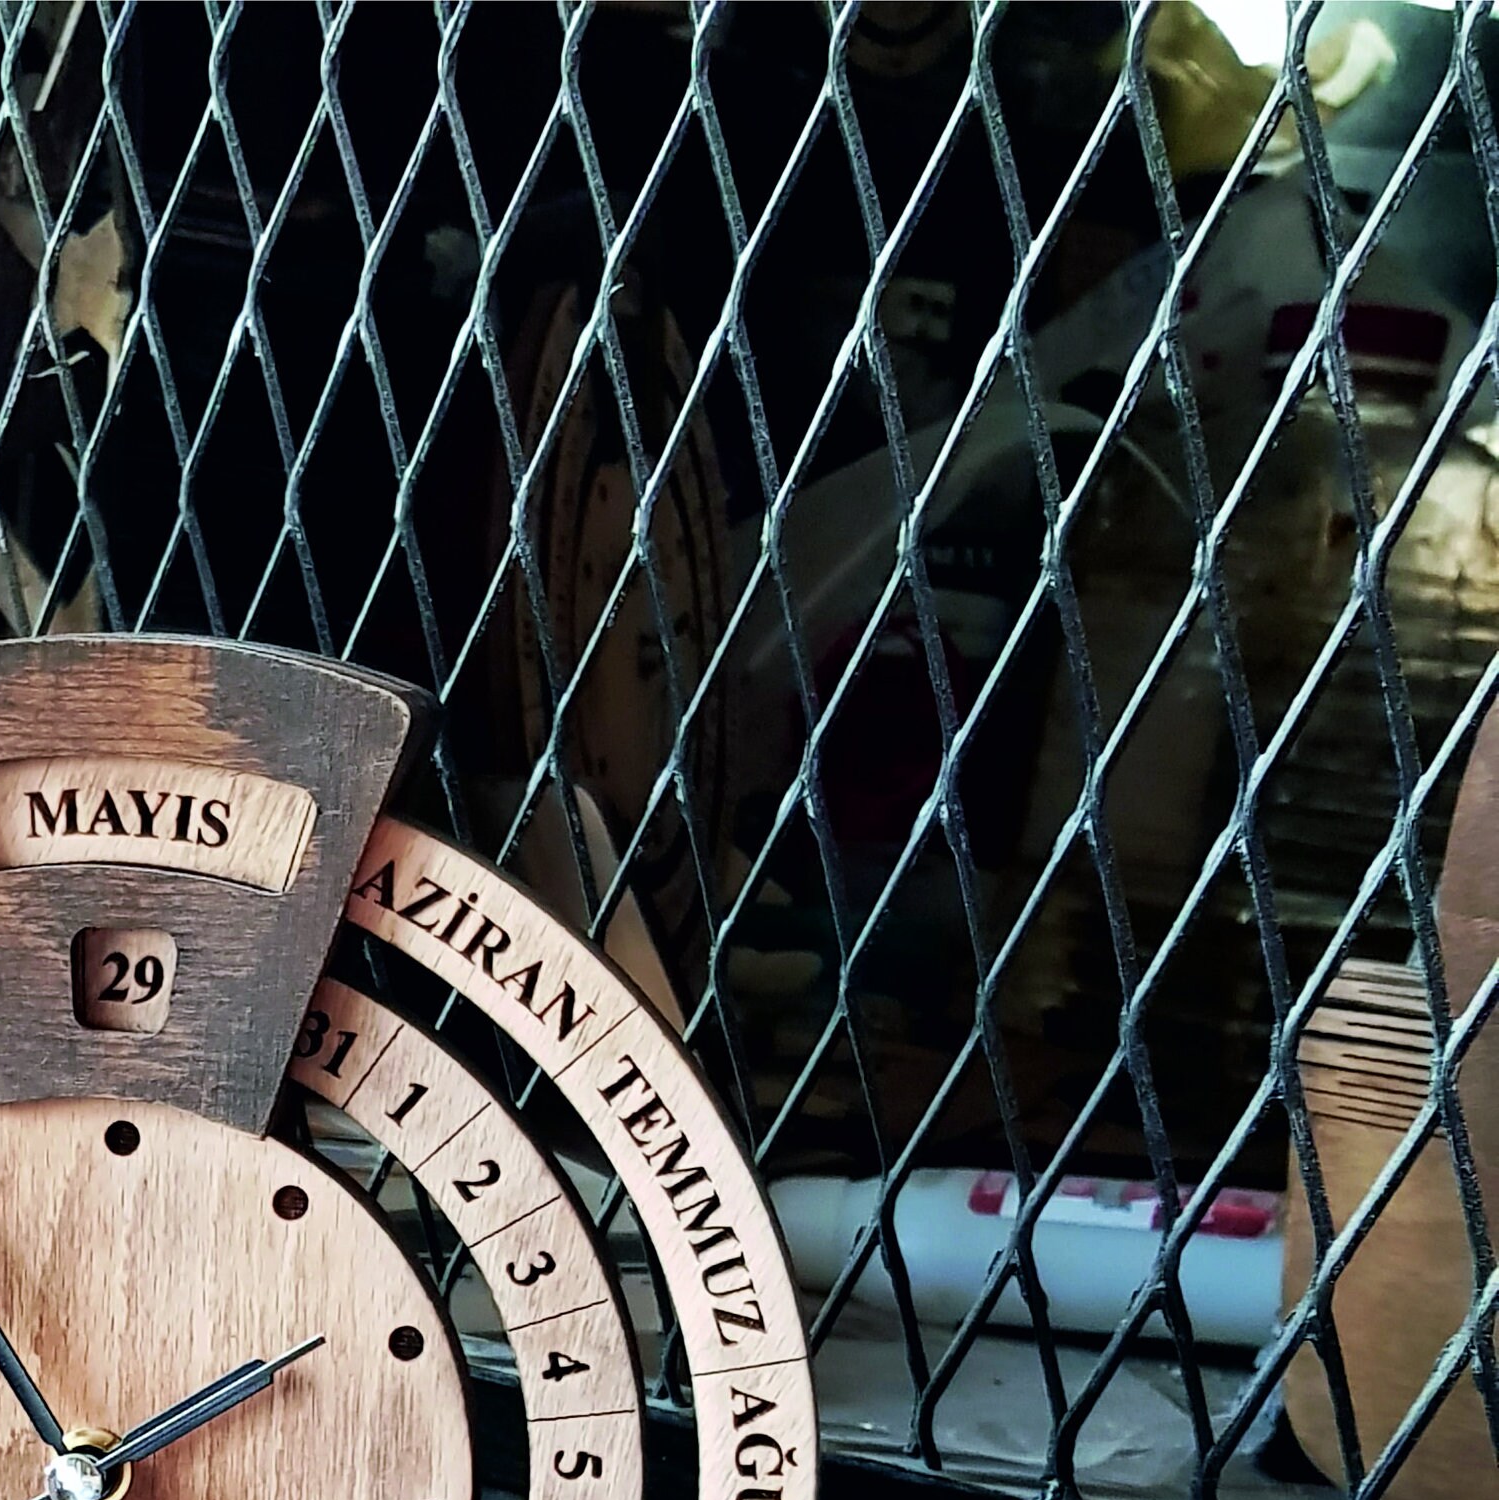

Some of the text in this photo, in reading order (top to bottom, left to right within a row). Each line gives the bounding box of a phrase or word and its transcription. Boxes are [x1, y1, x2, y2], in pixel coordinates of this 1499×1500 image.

[23, 787, 232, 848] MAYIS
[352, 859, 598, 1043] AZİRAN
[98, 951, 165, 1005] 29
[294, 1009, 359, 1080] 31
[383, 1080, 430, 1128] 1
[453, 1158, 502, 1205] 2
[595, 1053, 768, 1347] TEMMUZ
[505, 1250, 557, 1287] 3
[541, 1350, 591, 1382] 4
[553, 1448, 603, 1481] 5
